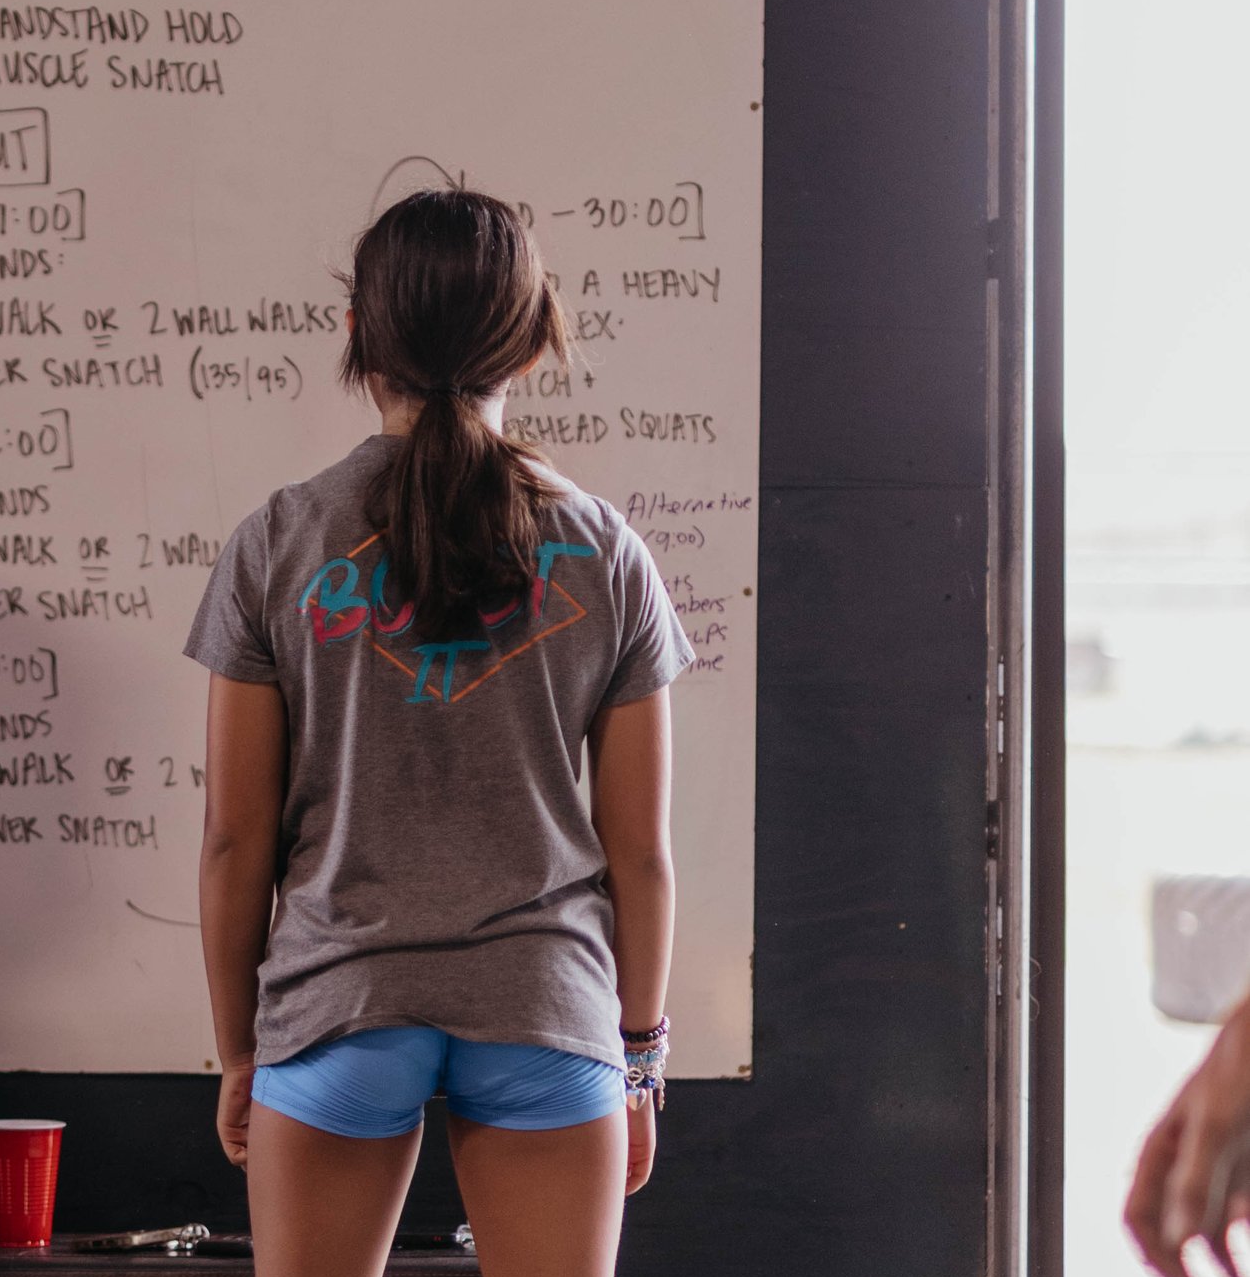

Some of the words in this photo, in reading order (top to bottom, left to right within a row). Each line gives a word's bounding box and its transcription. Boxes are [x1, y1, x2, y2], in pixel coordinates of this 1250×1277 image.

[164, 9, 244, 45] HOLD
[107, 55, 225, 95] SNATCH
[582, 269, 601, 297] A
[622, 266, 722, 303] HEAVY
[140, 300, 168, 336] 2
[171, 304, 240, 337] WALL
[247, 296, 339, 336] WALKS
[41, 352, 164, 389] SNATCH
[619, 406, 717, 445] SQUATS
[137, 532, 154, 569] 2
[37, 584, 154, 622] SNATCH
[158, 756, 179, 788] 2
[58, 813, 160, 851] SNATCH
